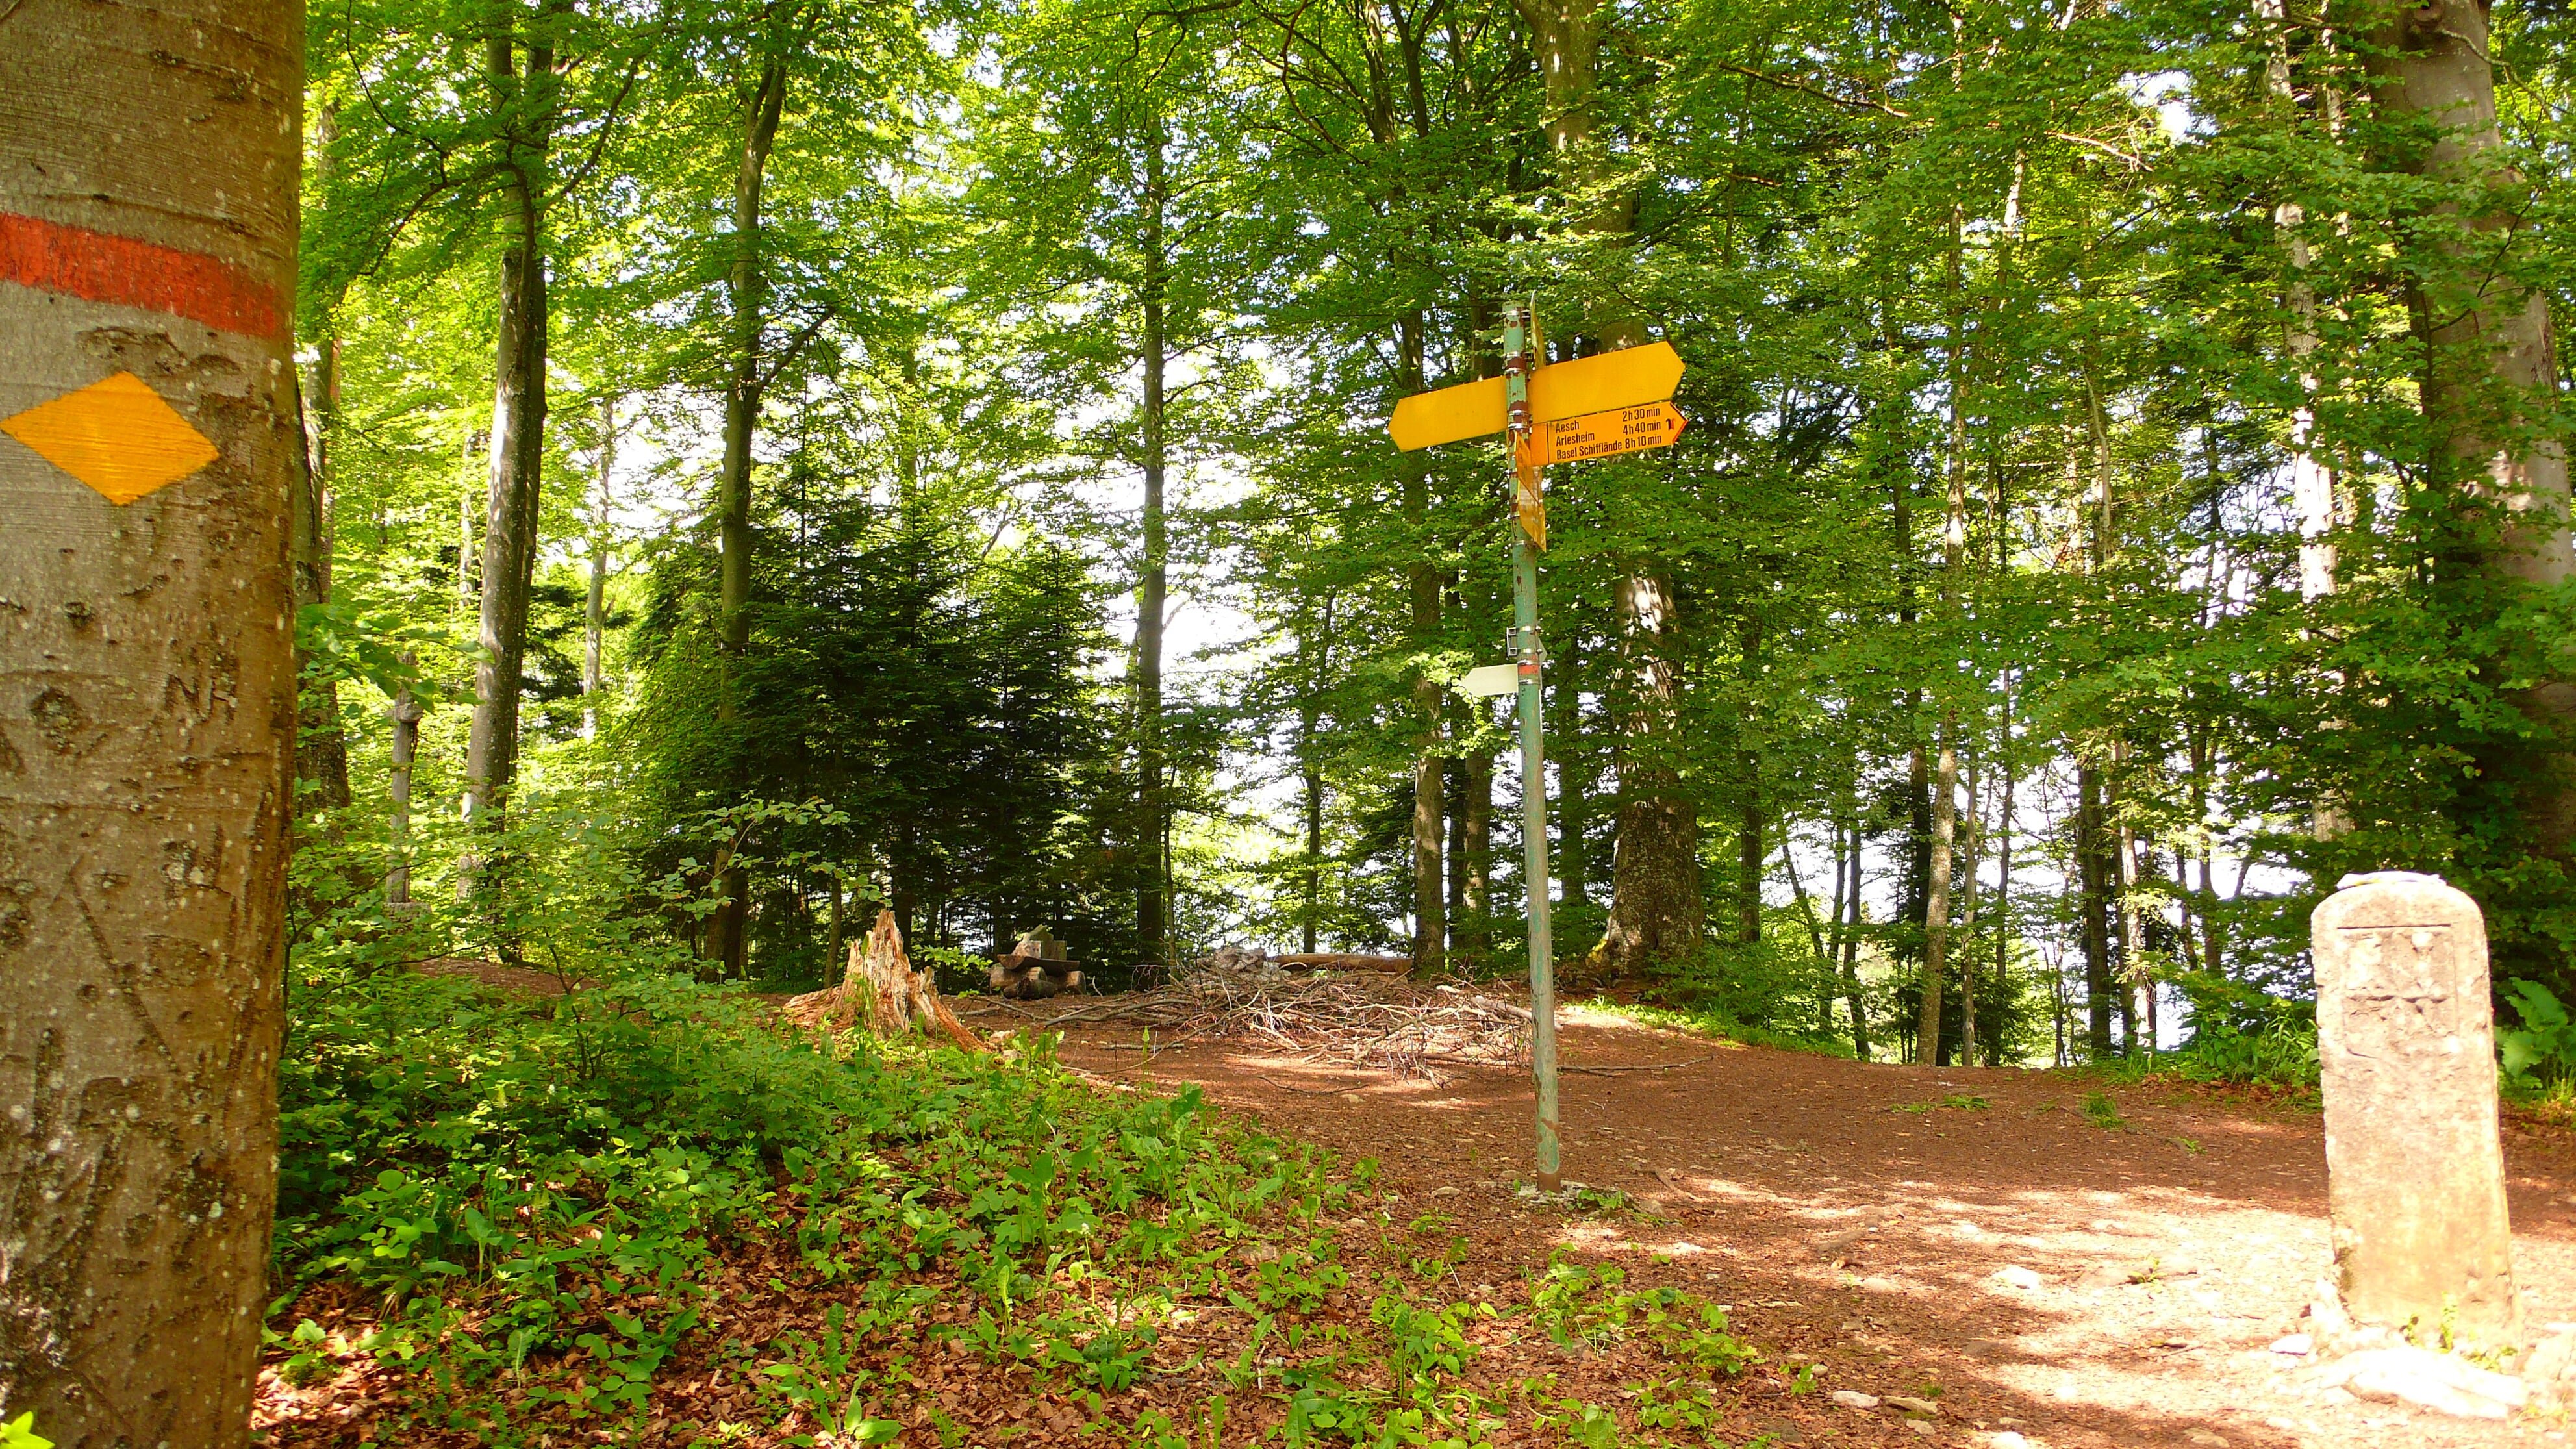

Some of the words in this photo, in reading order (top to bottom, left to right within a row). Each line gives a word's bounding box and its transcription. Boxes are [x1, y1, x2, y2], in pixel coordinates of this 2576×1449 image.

[1556, 420, 1580, 433] Aesch
[1556, 431, 1595, 447] Arlesheim
[1556, 447, 1577, 460] Basel
[1579, 440, 1623, 457] Schifflände
